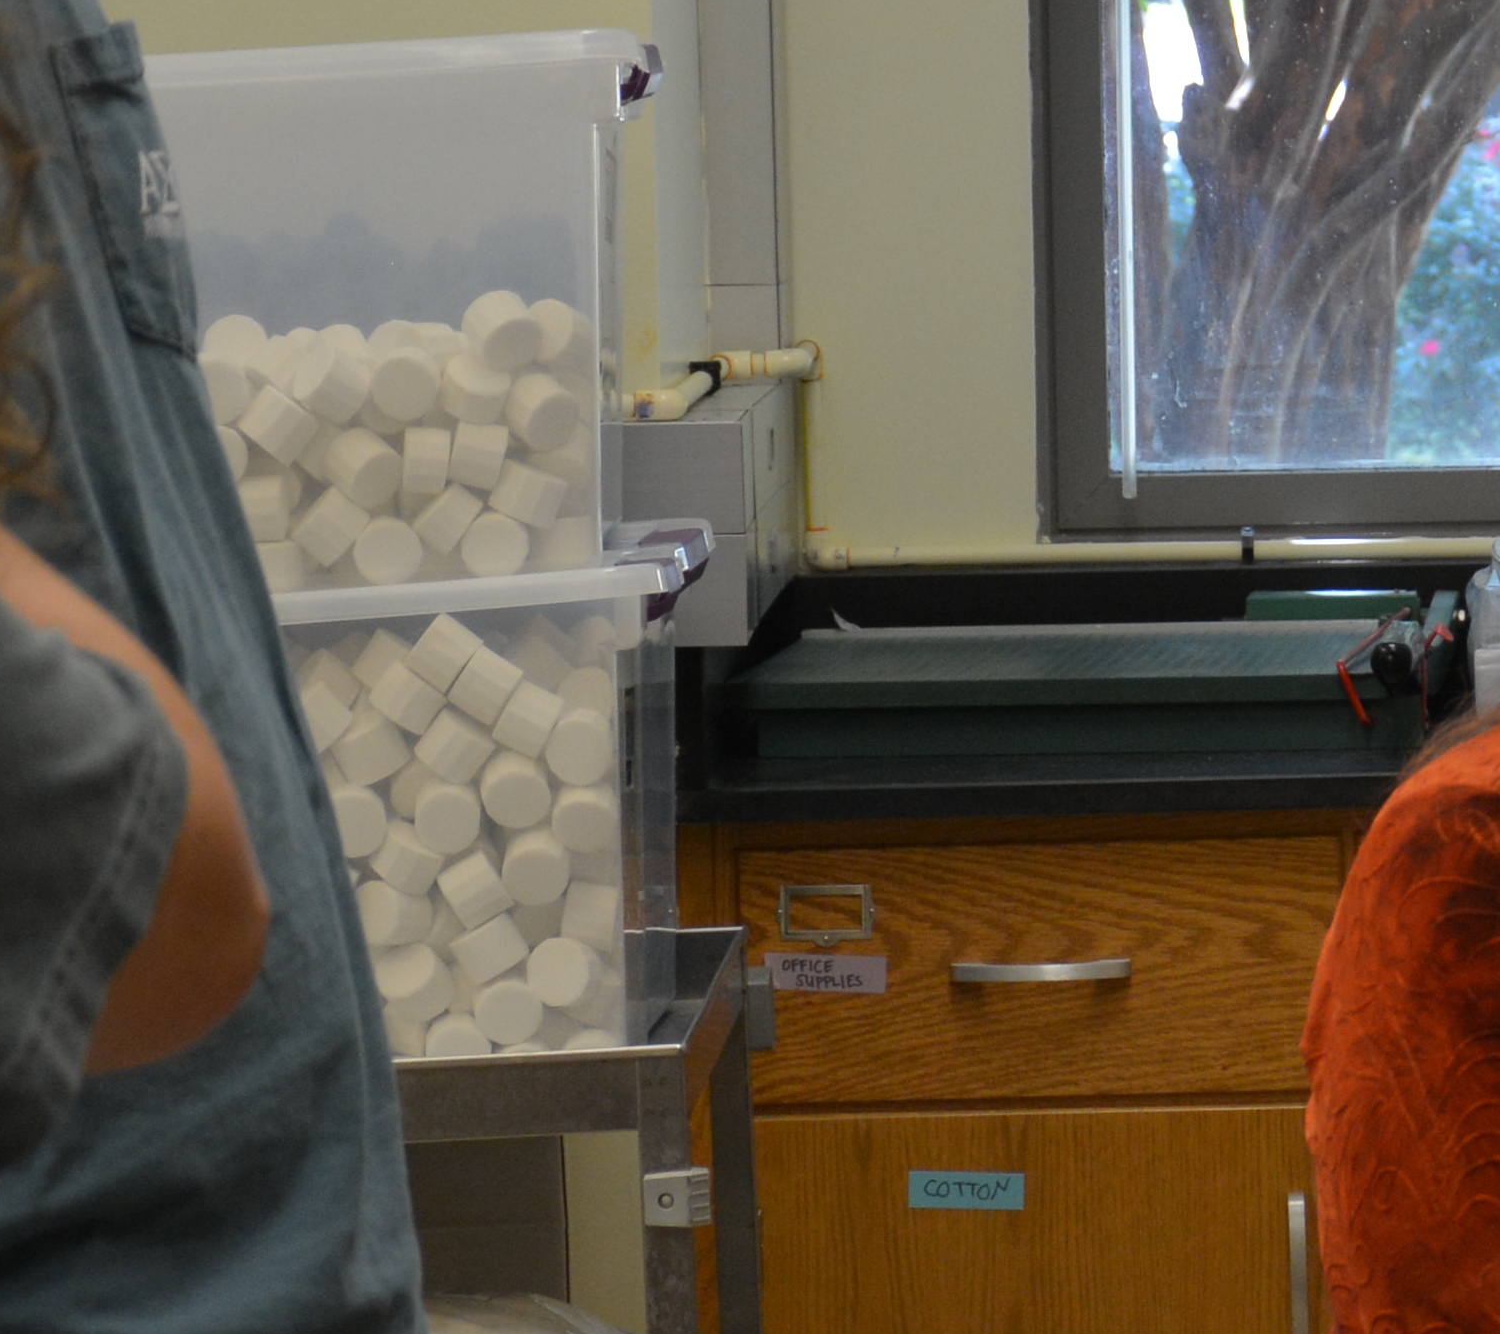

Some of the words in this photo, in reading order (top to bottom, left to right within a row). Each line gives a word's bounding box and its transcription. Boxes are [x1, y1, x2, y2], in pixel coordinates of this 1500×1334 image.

[782, 958, 834, 974] OFFICE
[796, 974, 863, 989] SUPPLIES
[924, 1177, 1011, 1201] COTTON
